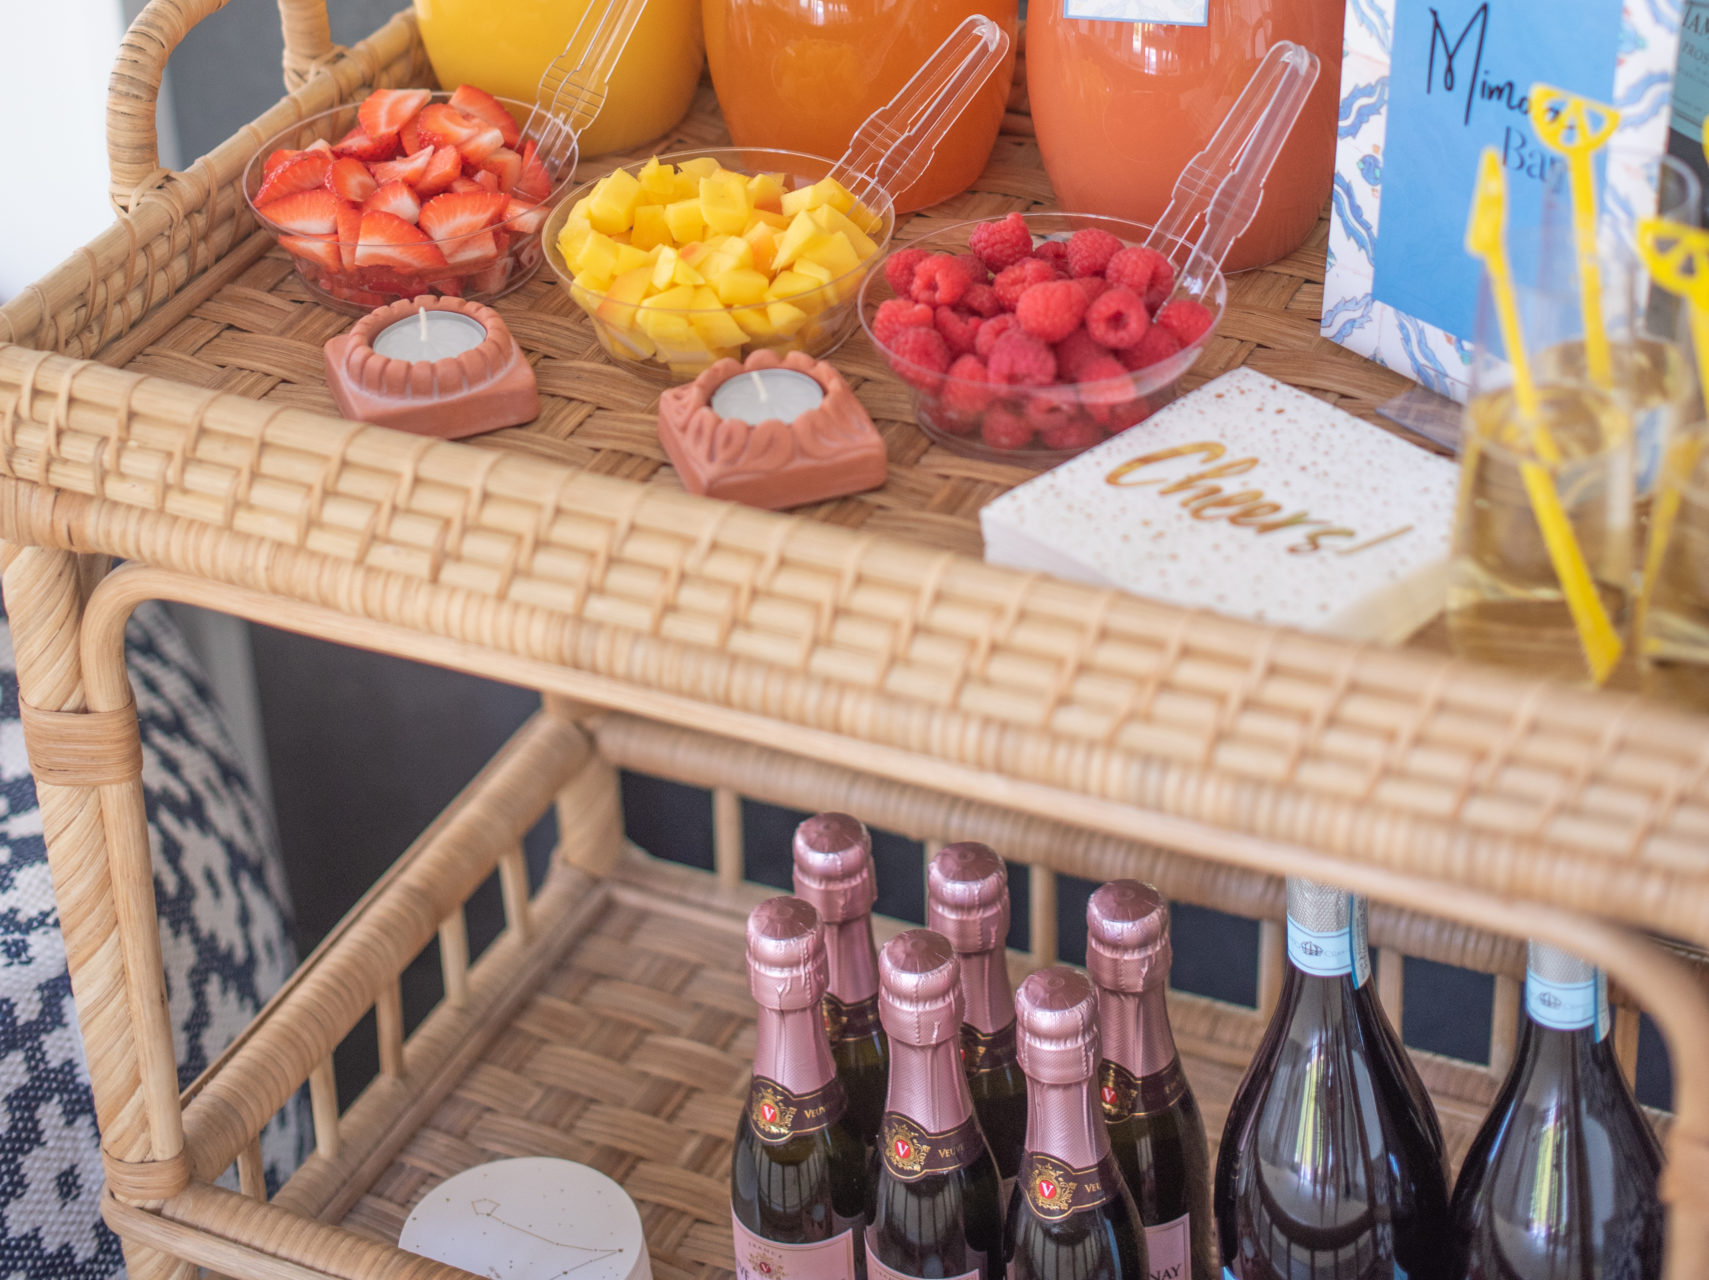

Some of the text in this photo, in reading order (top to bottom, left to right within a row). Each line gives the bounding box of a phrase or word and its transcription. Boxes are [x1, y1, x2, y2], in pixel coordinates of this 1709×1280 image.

[1426, 1, 1577, 130] Mimo
[1104, 441, 1415, 557] Cheers!
[763, 1104, 775, 1120] V
[897, 1141, 909, 1157] V
[1041, 1182, 1054, 1198] V
